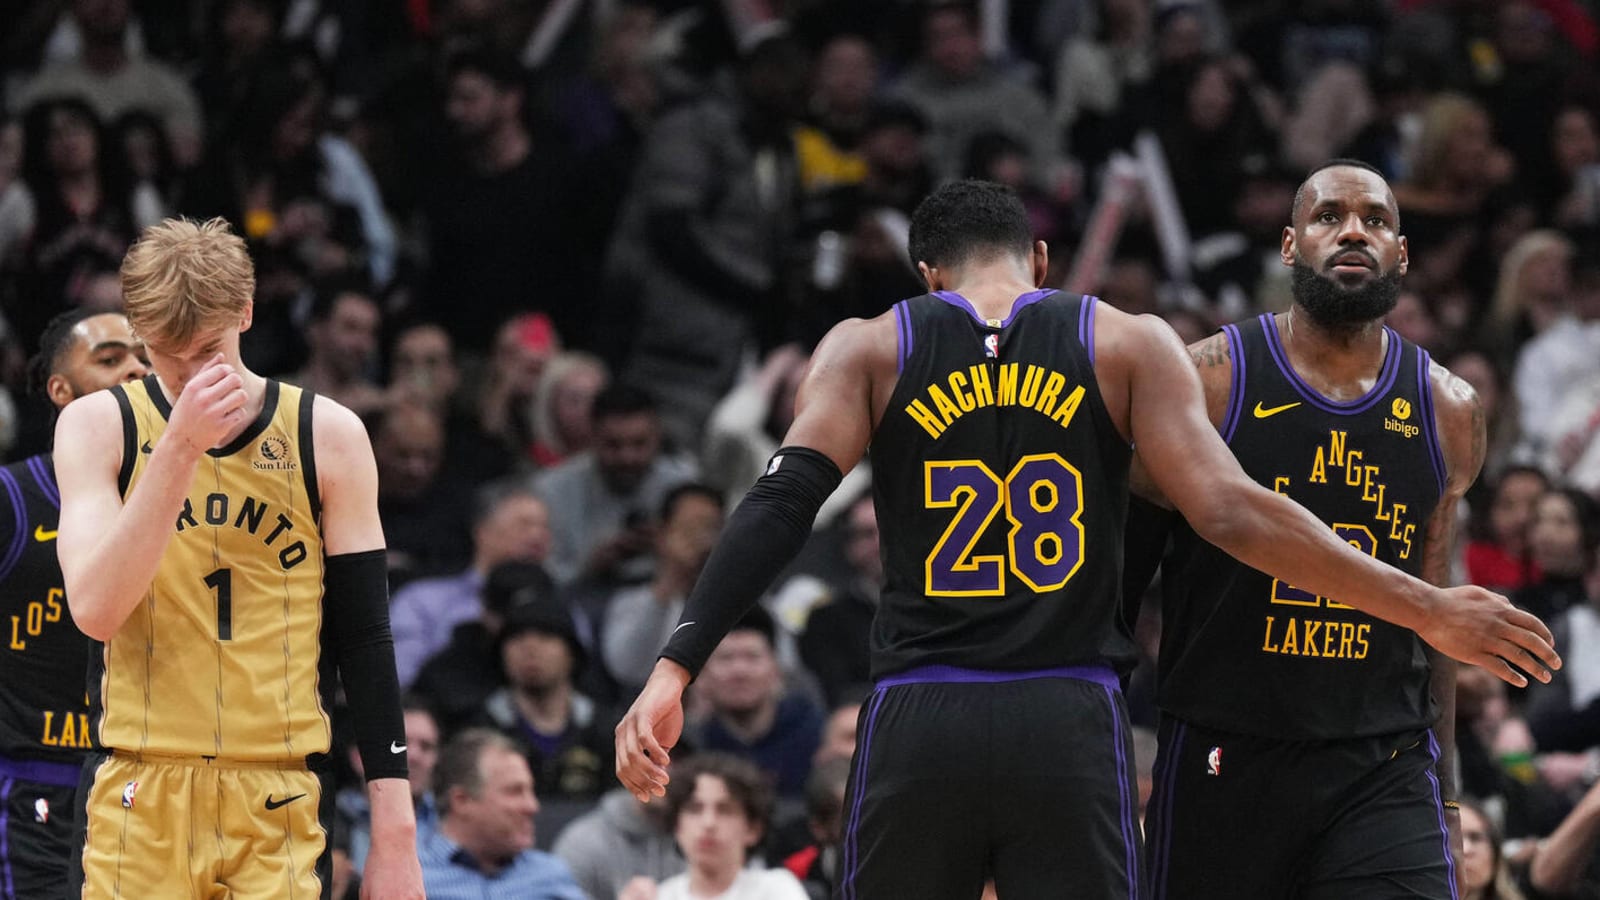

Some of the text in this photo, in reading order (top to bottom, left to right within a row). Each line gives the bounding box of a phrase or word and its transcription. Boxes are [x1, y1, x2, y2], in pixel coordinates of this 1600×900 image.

[905, 362, 1086, 440] HACHMURA
[1384, 417, 1419, 439] bibigo
[253, 461, 297, 470] Sun Life
[1309, 430, 1416, 559] ANGELES
[924, 452, 1085, 597] 28
[9, 587, 64, 650] LOS
[203, 568, 232, 641] 1
[1262, 616, 1371, 659] LAKERS
